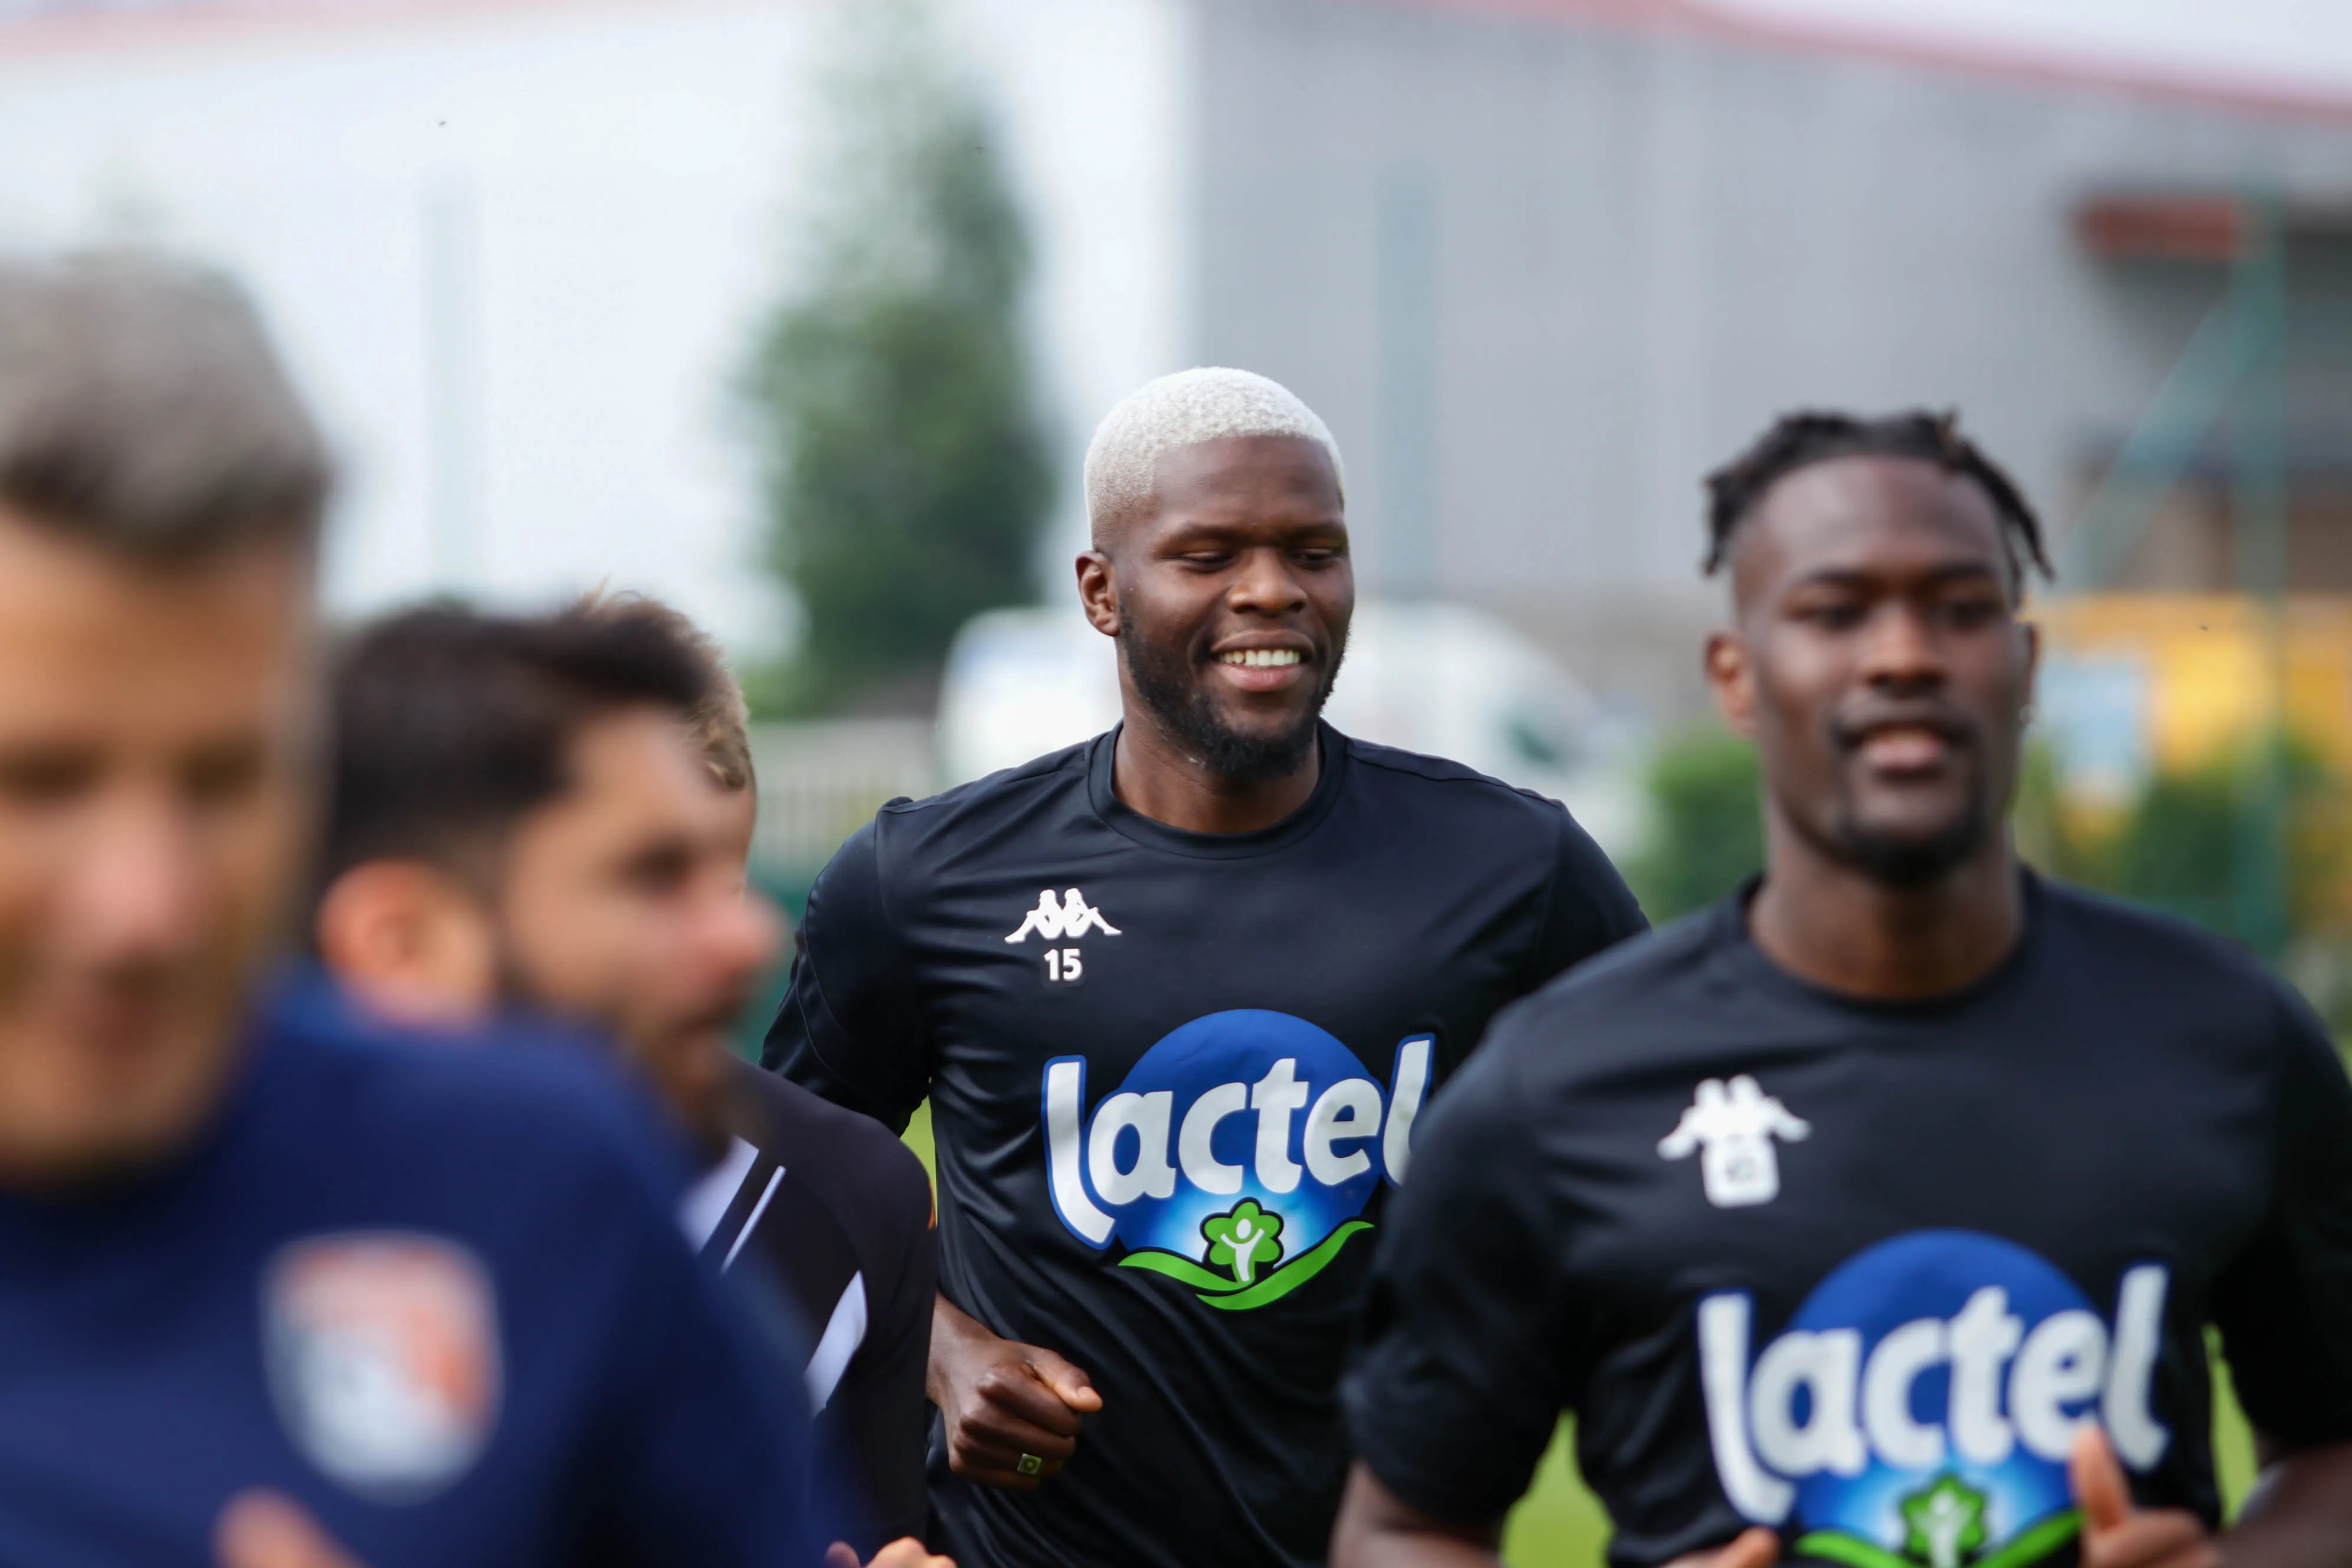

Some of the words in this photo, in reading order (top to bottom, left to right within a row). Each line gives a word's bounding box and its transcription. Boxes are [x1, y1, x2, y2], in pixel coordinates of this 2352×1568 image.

[1044, 949, 1083, 981] 15
[1044, 1037, 1432, 1245] lactel
[1697, 1263, 2171, 1526] lactel
